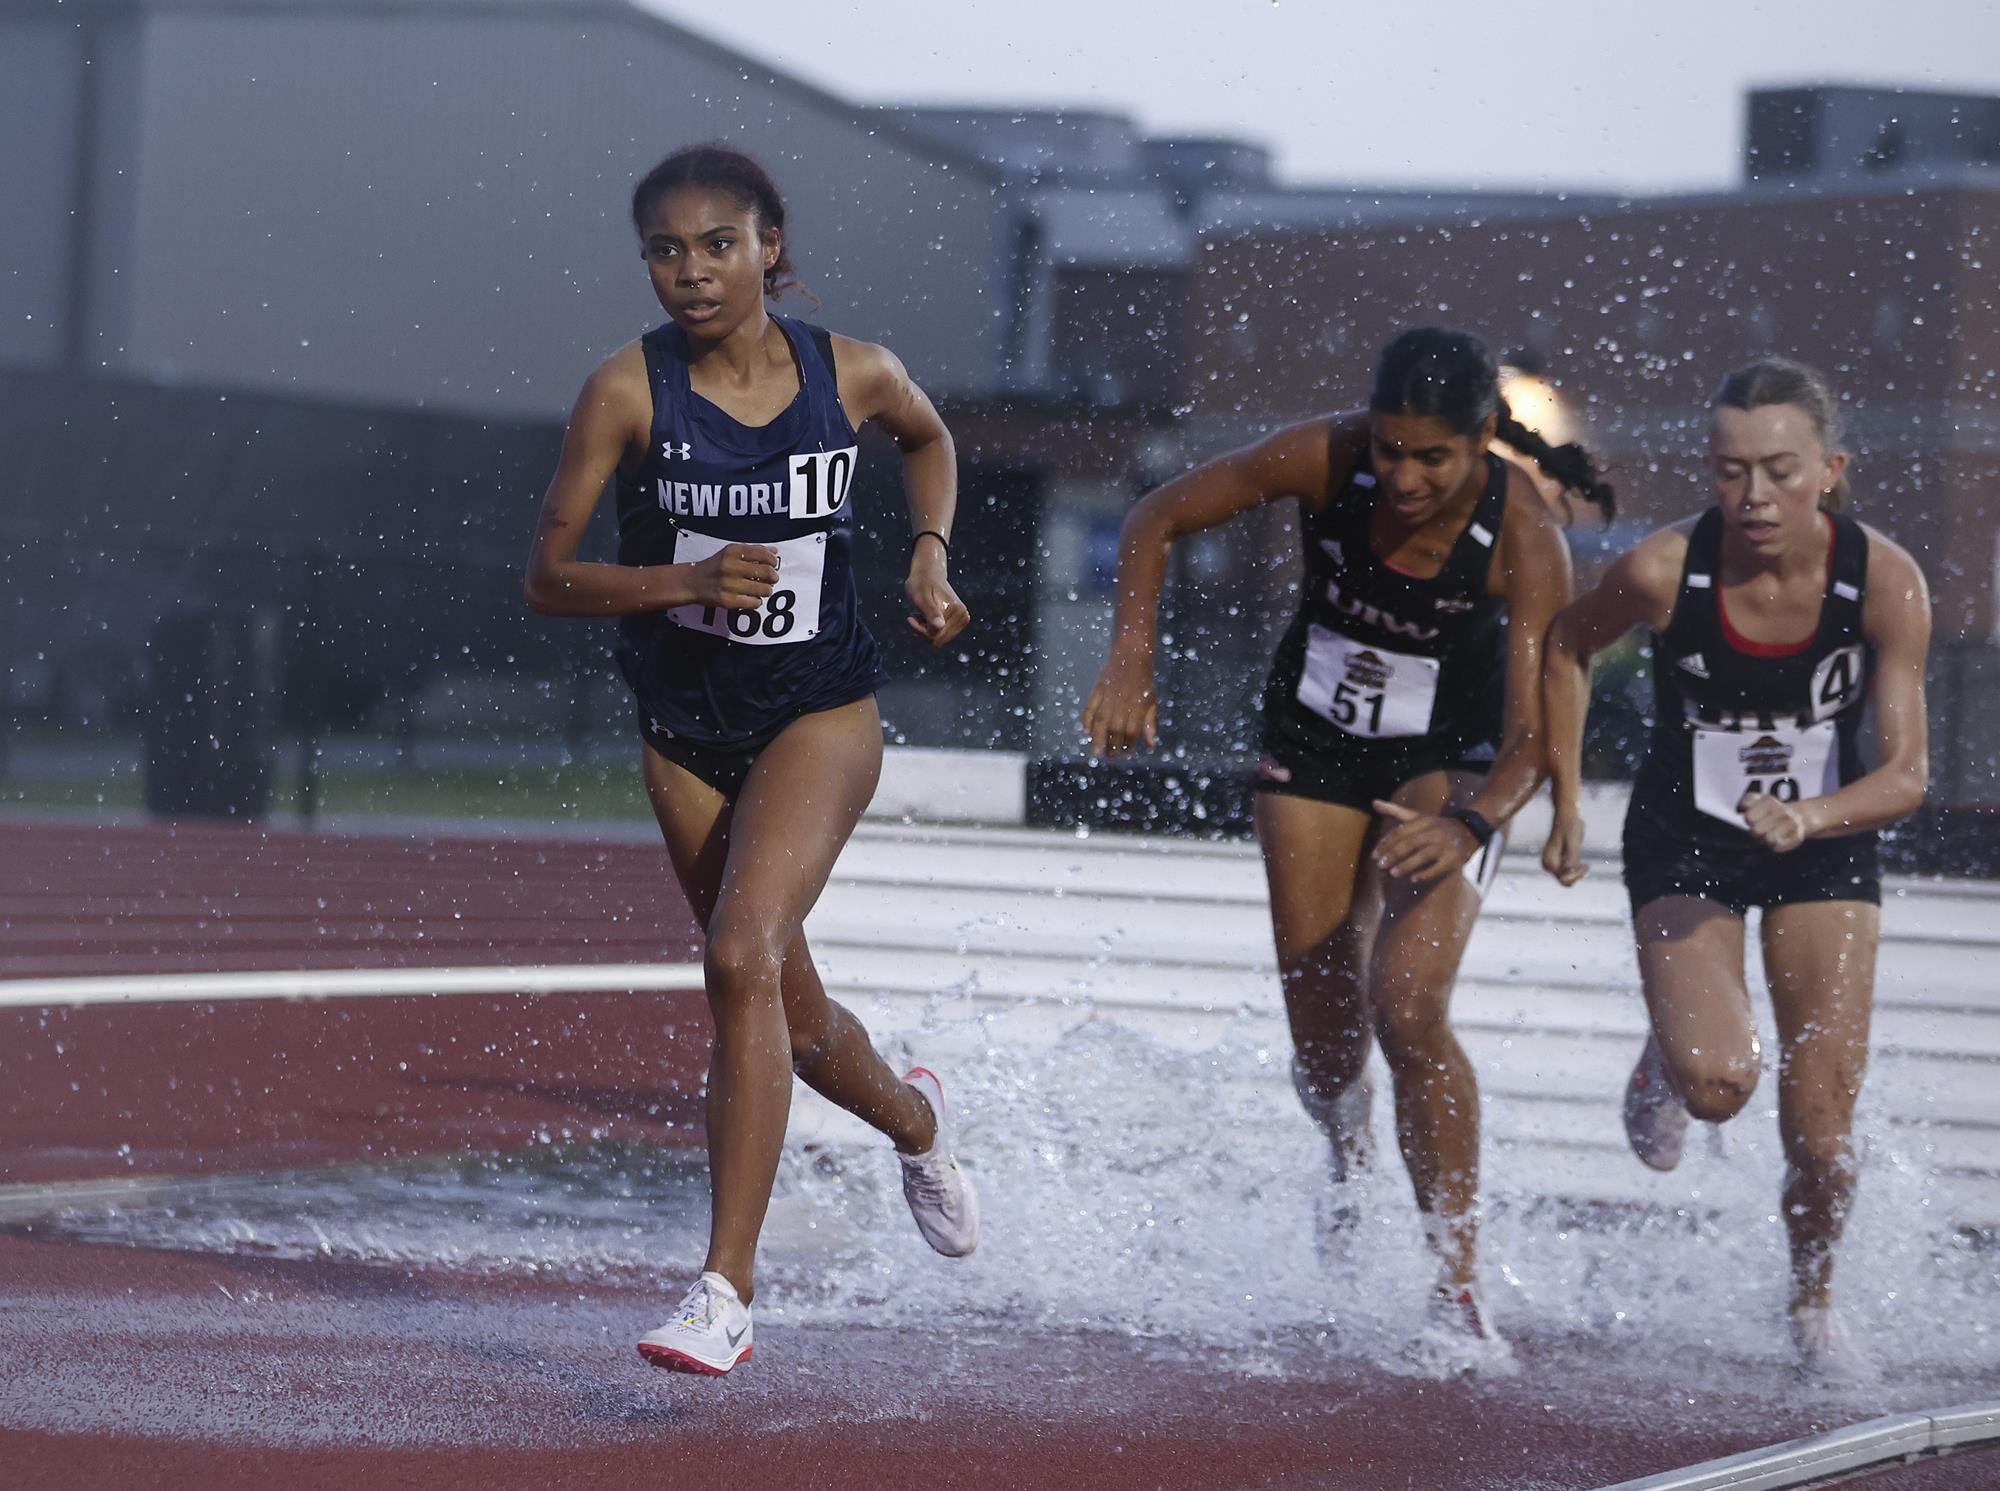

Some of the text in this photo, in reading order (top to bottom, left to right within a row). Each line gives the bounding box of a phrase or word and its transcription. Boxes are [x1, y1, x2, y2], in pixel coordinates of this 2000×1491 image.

[657, 478, 788, 517] NEW ORL
[796, 451, 850, 515] 10
[1327, 580, 1440, 640] UIW
[1820, 653, 1855, 705] 4
[1329, 681, 1385, 733] 51
